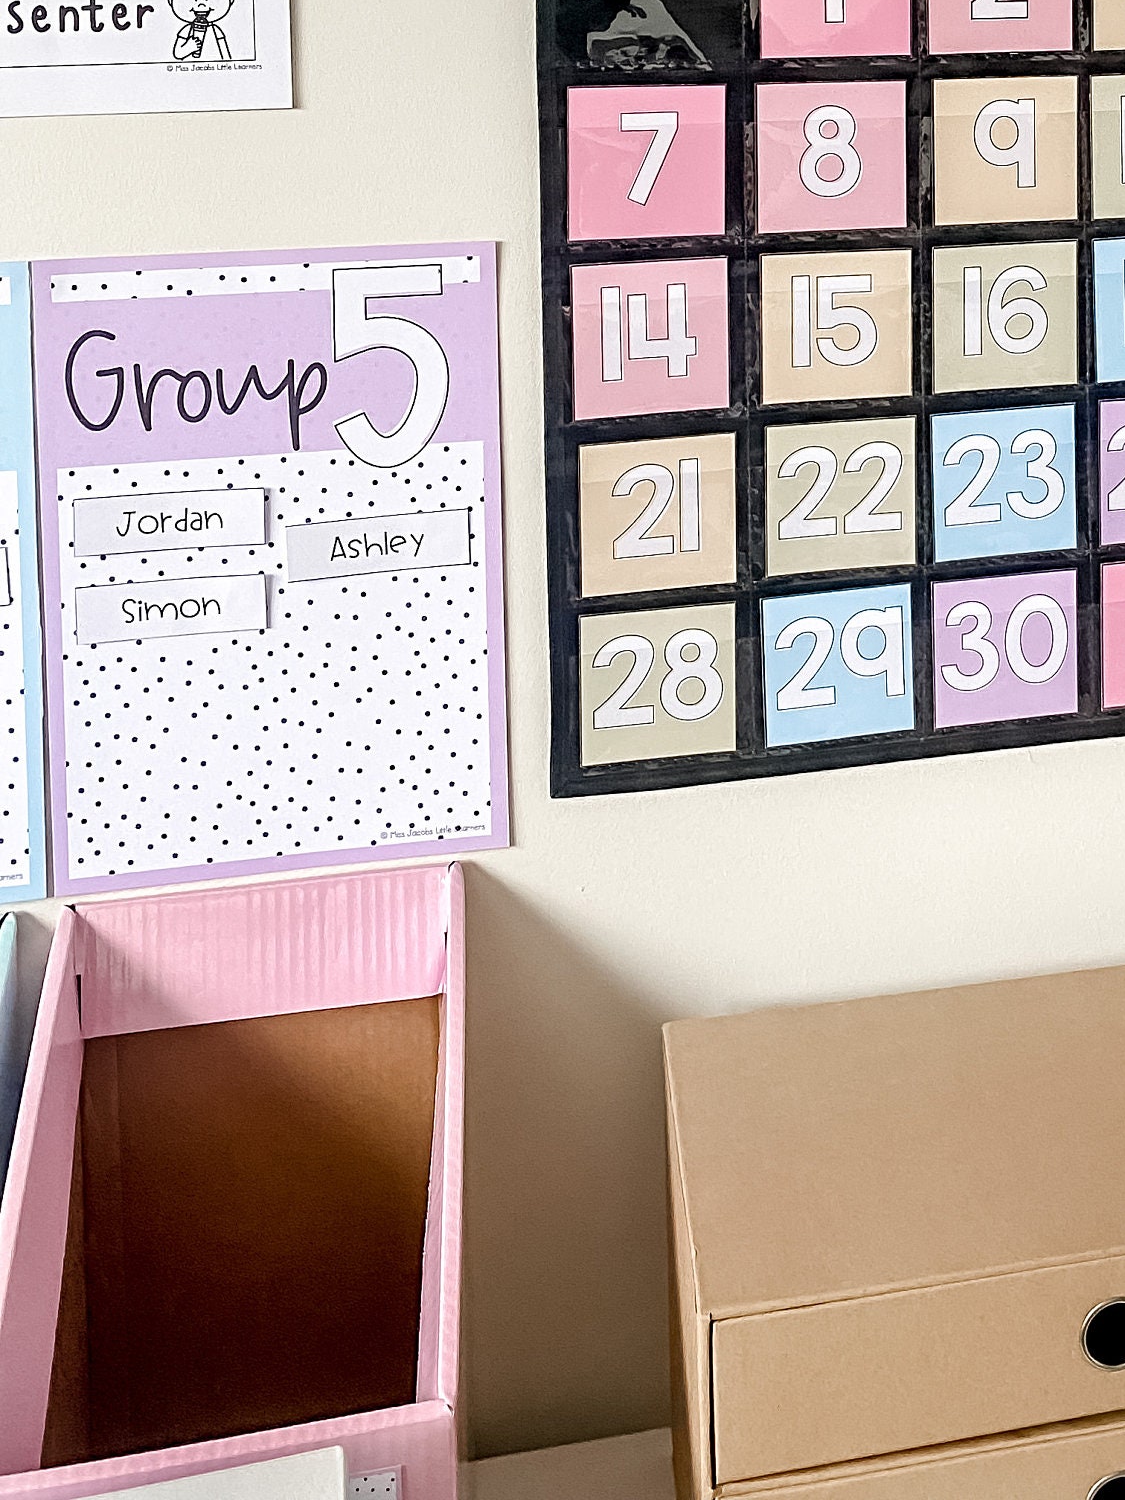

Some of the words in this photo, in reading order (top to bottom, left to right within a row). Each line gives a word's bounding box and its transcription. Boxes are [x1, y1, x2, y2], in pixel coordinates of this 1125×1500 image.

[620, 111, 679, 206] 7
[800, 105, 862, 197] 8
[974, 99, 1036, 188] 9
[64, 329, 328, 452] Group
[331, 262, 451, 469] 5
[601, 283, 697, 382] 14
[791, 274, 878, 367] 15
[963, 266, 1049, 356] 16
[115, 508, 225, 539] Jordan
[329, 528, 425, 562] Ashley
[612, 458, 700, 559] 21
[777, 441, 903, 539] 22
[943, 429, 1065, 526] 23
[121, 595, 221, 625] Simon
[593, 628, 723, 730] 28
[775, 606, 905, 710] 29
[941, 594, 1068, 691] 30
